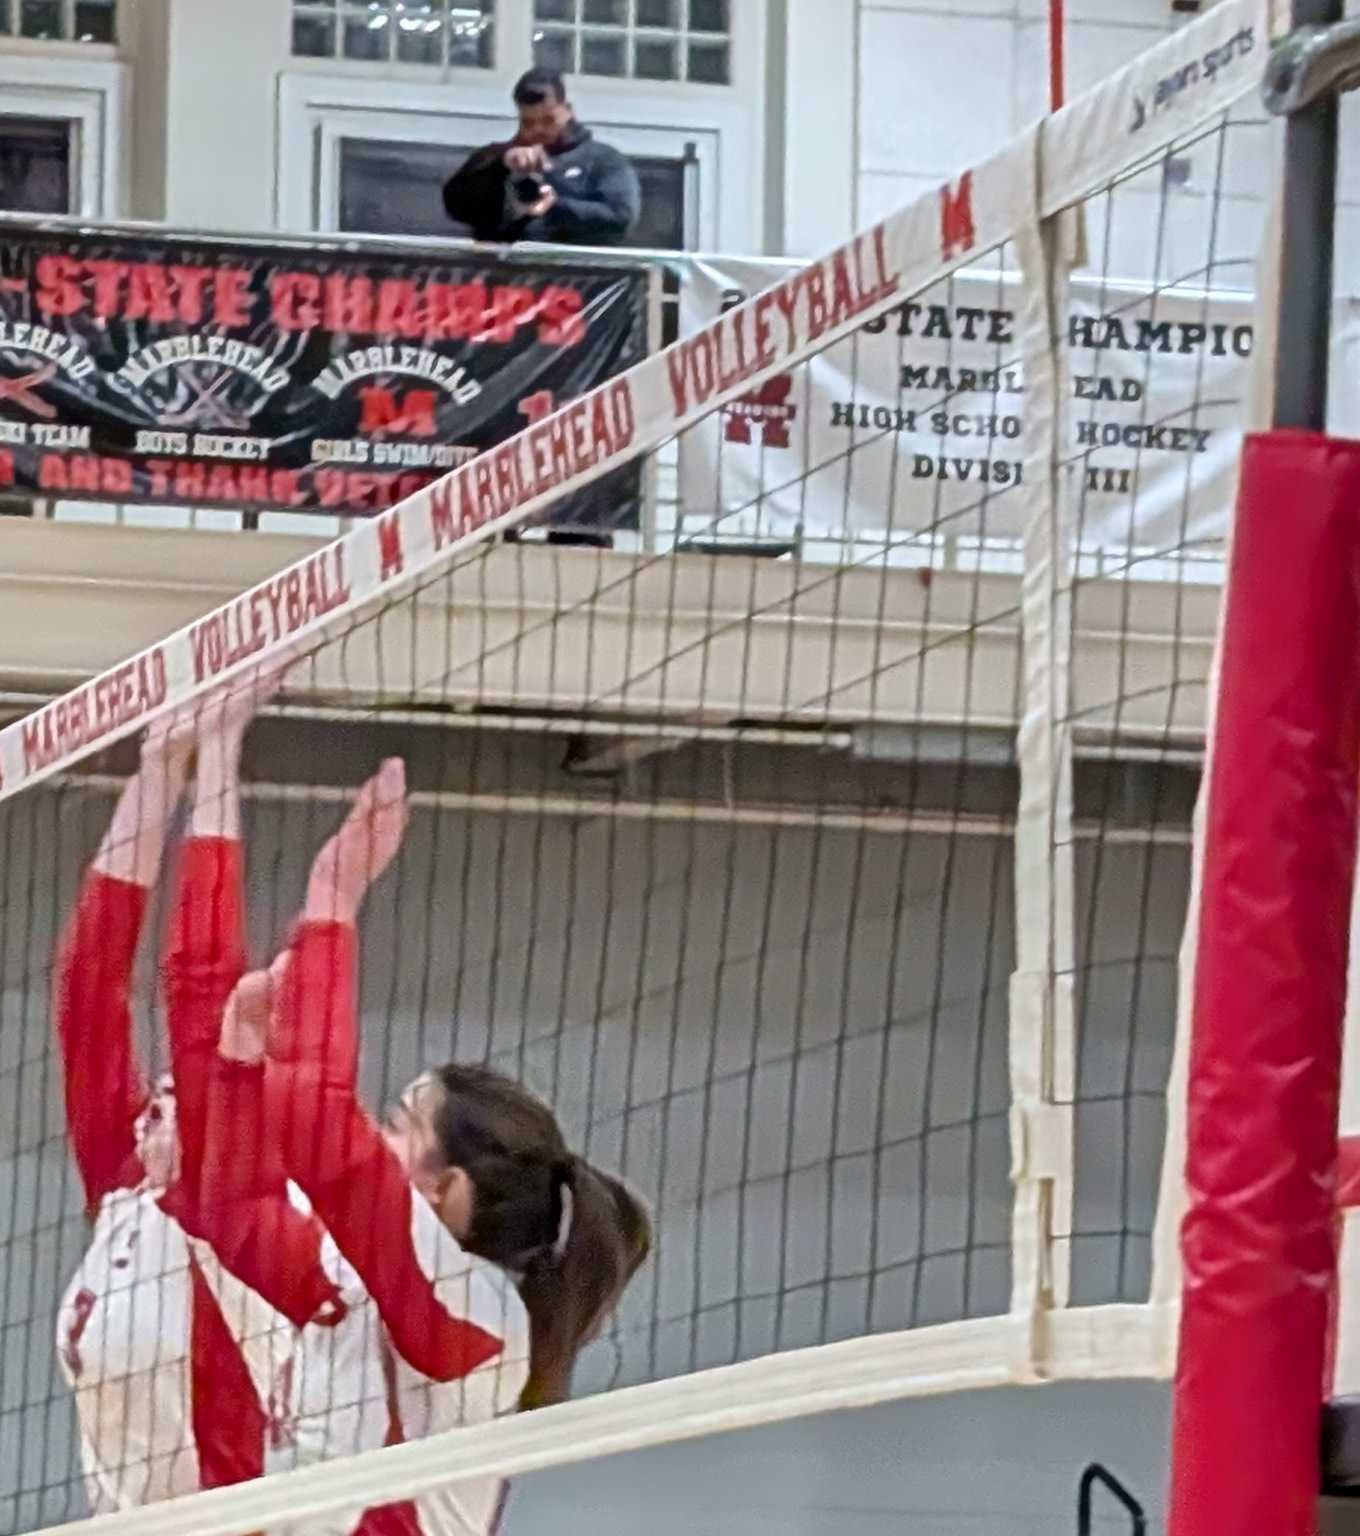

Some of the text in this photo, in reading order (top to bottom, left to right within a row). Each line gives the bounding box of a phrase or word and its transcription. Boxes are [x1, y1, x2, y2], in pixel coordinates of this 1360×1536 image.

[270, 272, 588, 346] CHAMPS
[118, 333, 291, 393] MARBLEHEAD
[310, 343, 483, 406] MARBLEHEAD
[31, 422, 91, 448] TEAM
[357, 384, 439, 437] M
[831, 402, 917, 432] HIGH
[1077, 422, 1211, 453] HOCKEY
[22, 648, 166, 772] MARBLEHEAD
[191, 540, 351, 684] VOLLEYBALL
[378, 512, 403, 581] M
[432, 378, 634, 552] MARBLEHEAD
[668, 224, 900, 420] VOLLEYBALL
[941, 170, 973, 260] M
[38, 454, 133, 492] AND
[1087, 468, 1130, 493] III
